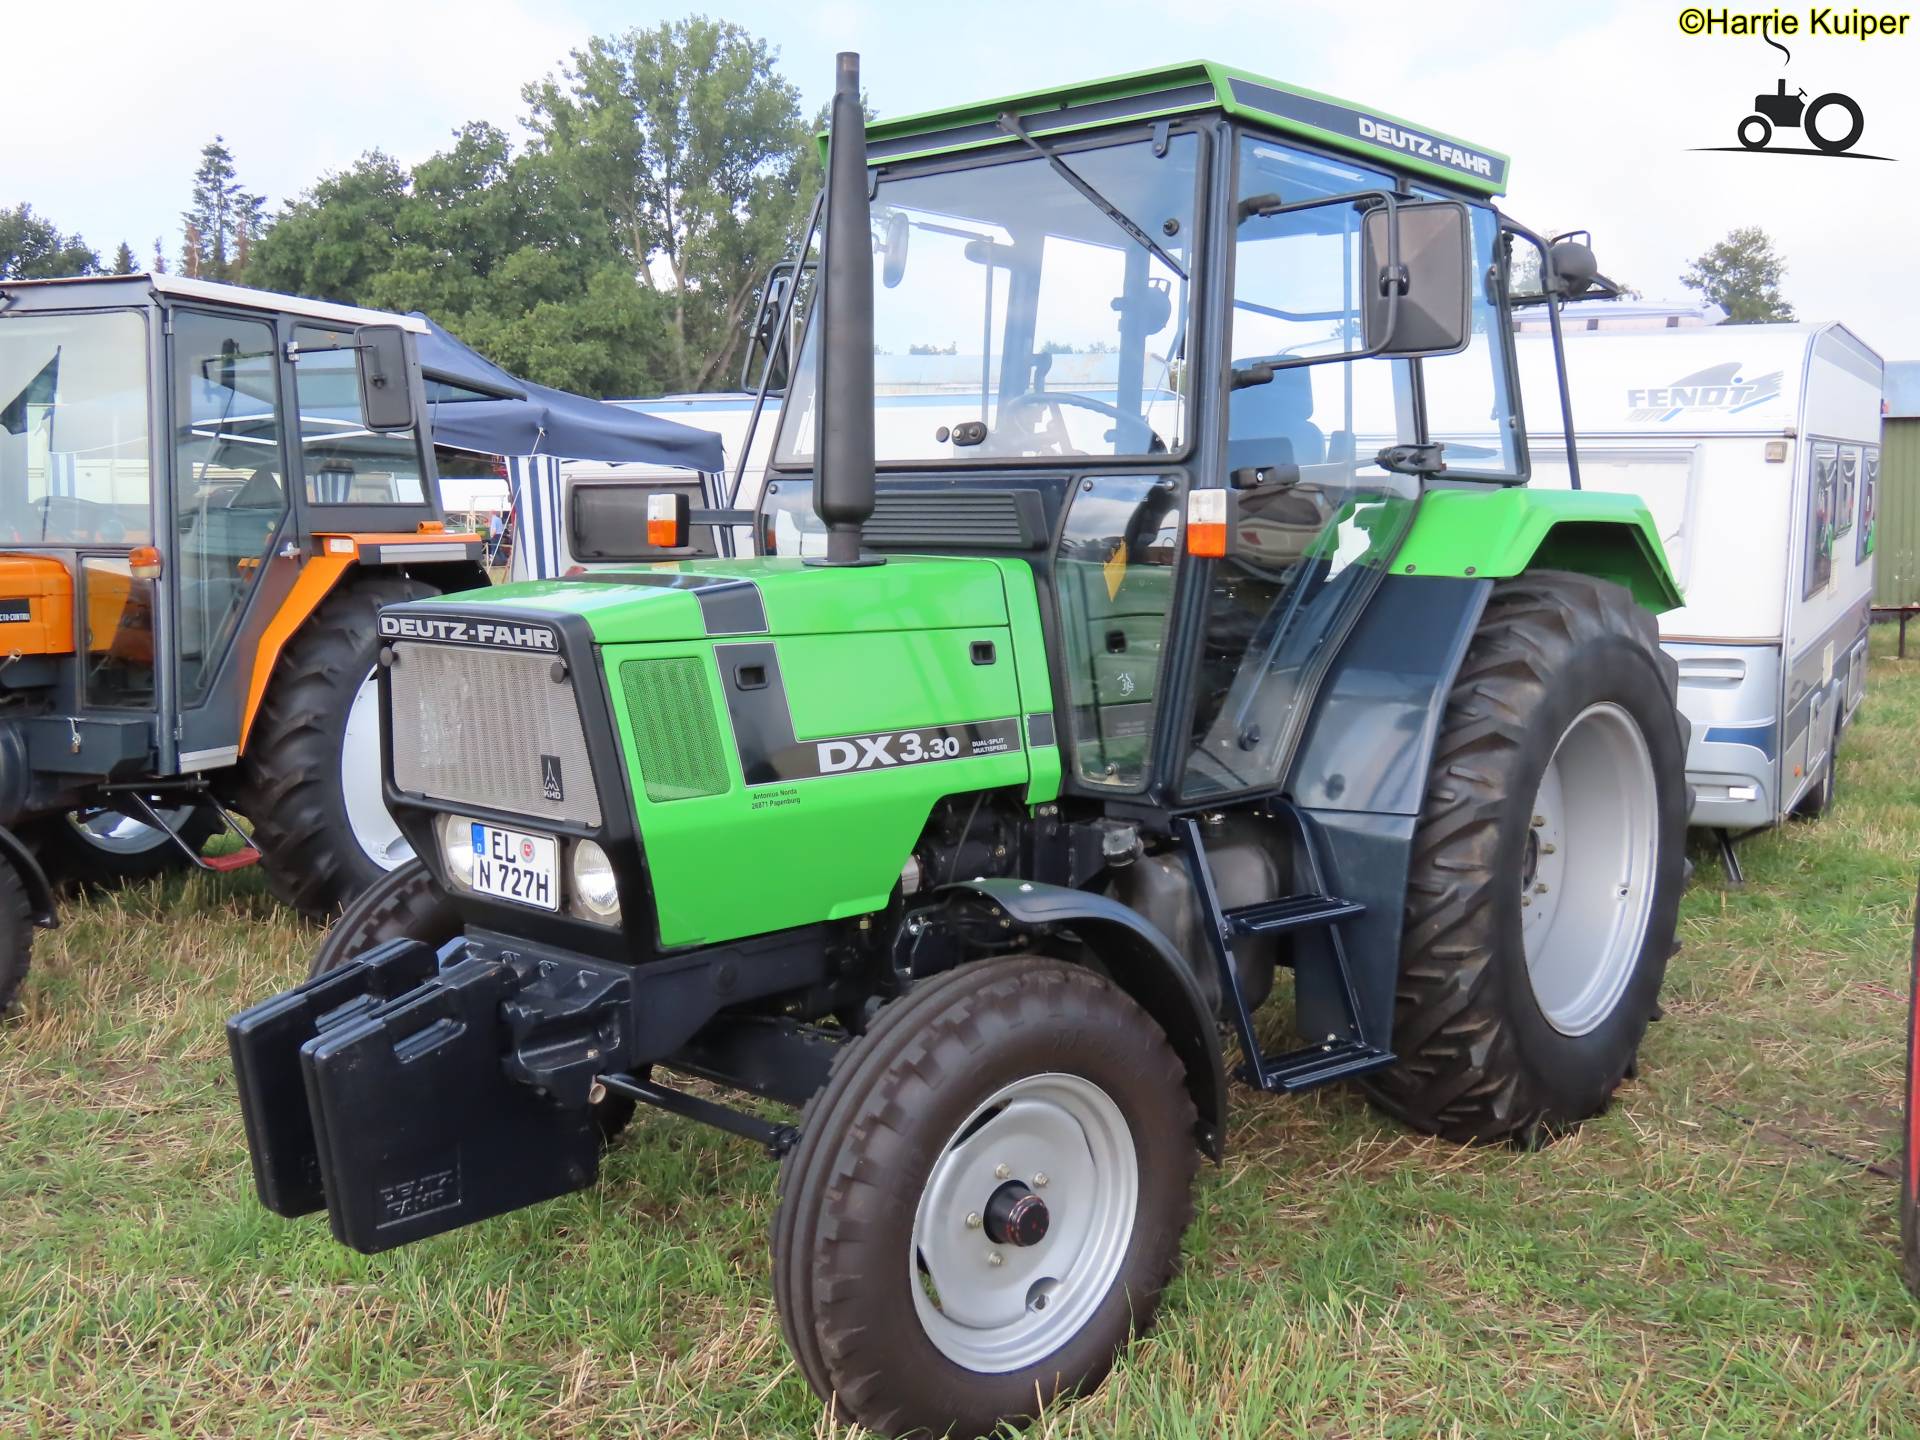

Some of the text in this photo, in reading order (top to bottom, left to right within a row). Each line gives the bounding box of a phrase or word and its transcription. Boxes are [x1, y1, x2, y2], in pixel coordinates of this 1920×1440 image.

[1358, 117, 1491, 177] DEUTZ-FAHR
[1627, 387, 1754, 407] FENDT
[381, 617, 553, 648] DEUTZ-FAHR
[817, 733, 960, 773] DX 3.30
[543, 790, 561, 800] KHD
[492, 831, 516, 863] EL
[479, 860, 549, 903] N 727H
